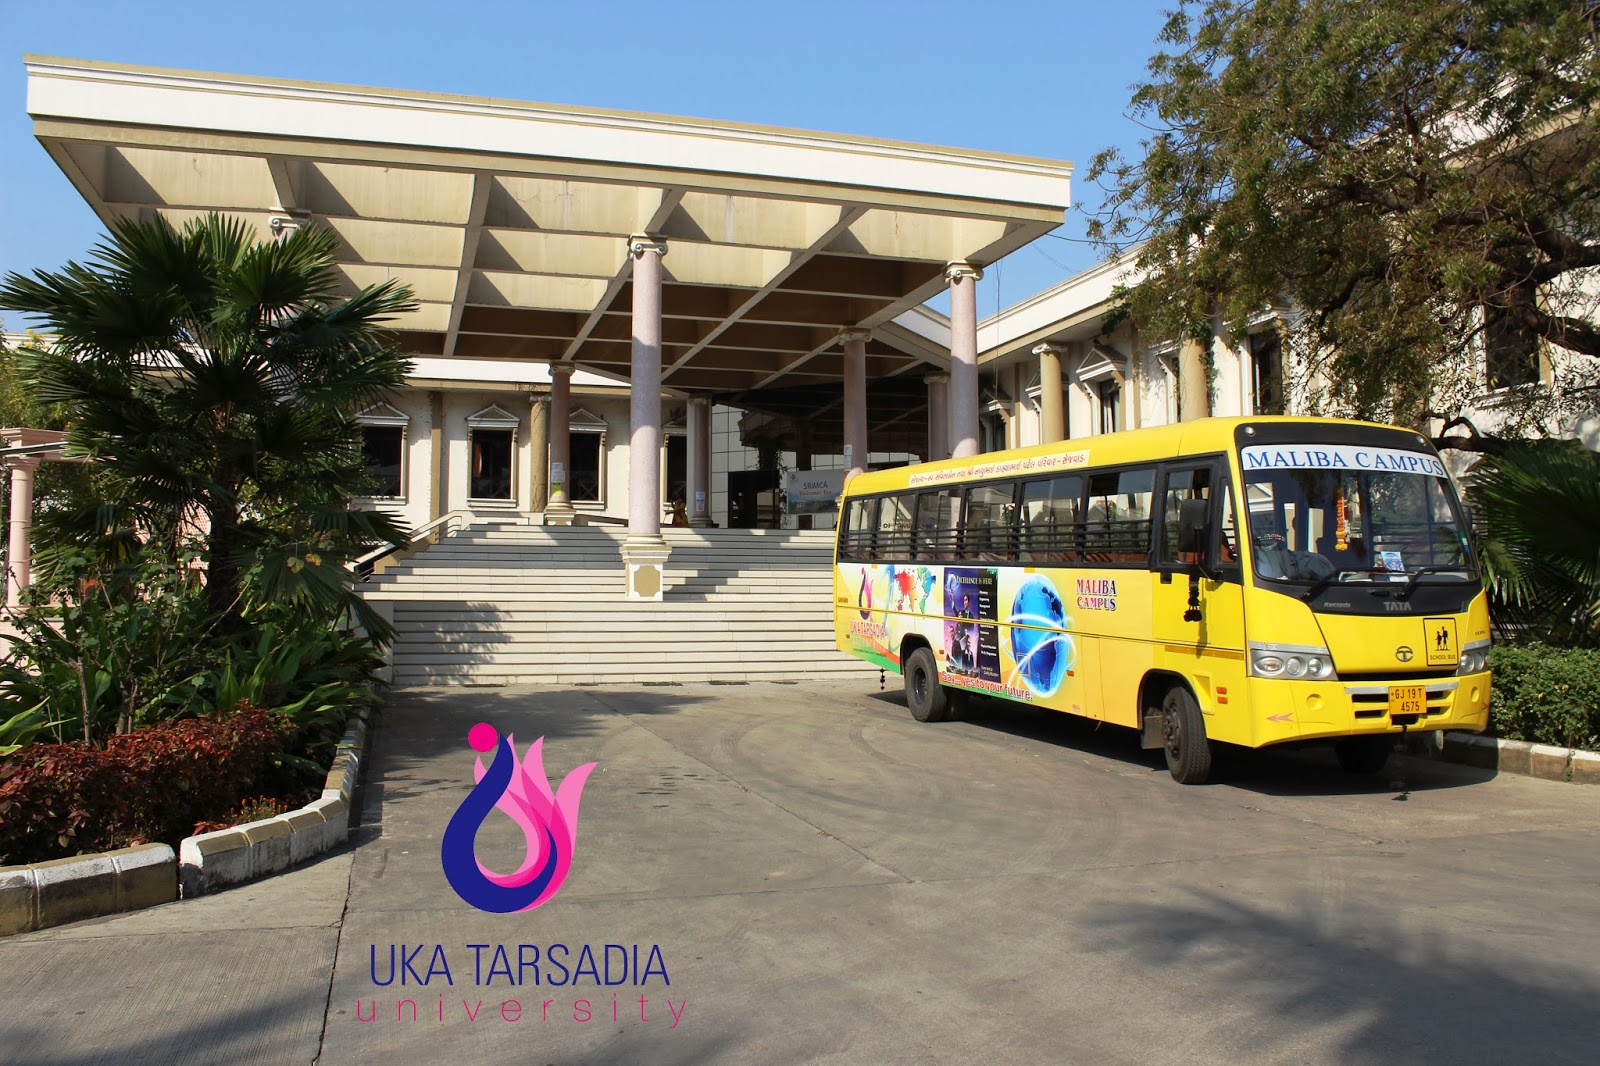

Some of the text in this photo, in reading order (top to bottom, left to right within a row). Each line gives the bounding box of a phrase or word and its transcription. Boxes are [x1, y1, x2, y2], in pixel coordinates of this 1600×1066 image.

[1038, 456, 1056, 467] પરિવાર
[1247, 451, 1443, 476] MALIBA CAMPUS
[803, 481, 828, 490] SRIMCA
[1076, 578, 1117, 596] MALIBA
[1076, 596, 1117, 611] CAMPUS
[1383, 601, 1412, 611] TATA
[961, 676, 976, 688] yes
[976, 679, 984, 689] to
[986, 682, 1003, 694] your
[1004, 683, 1033, 701] future.
[1395, 689, 1405, 699] GJ
[1407, 688, 1416, 699] 19
[1401, 701, 1420, 712] 4575
